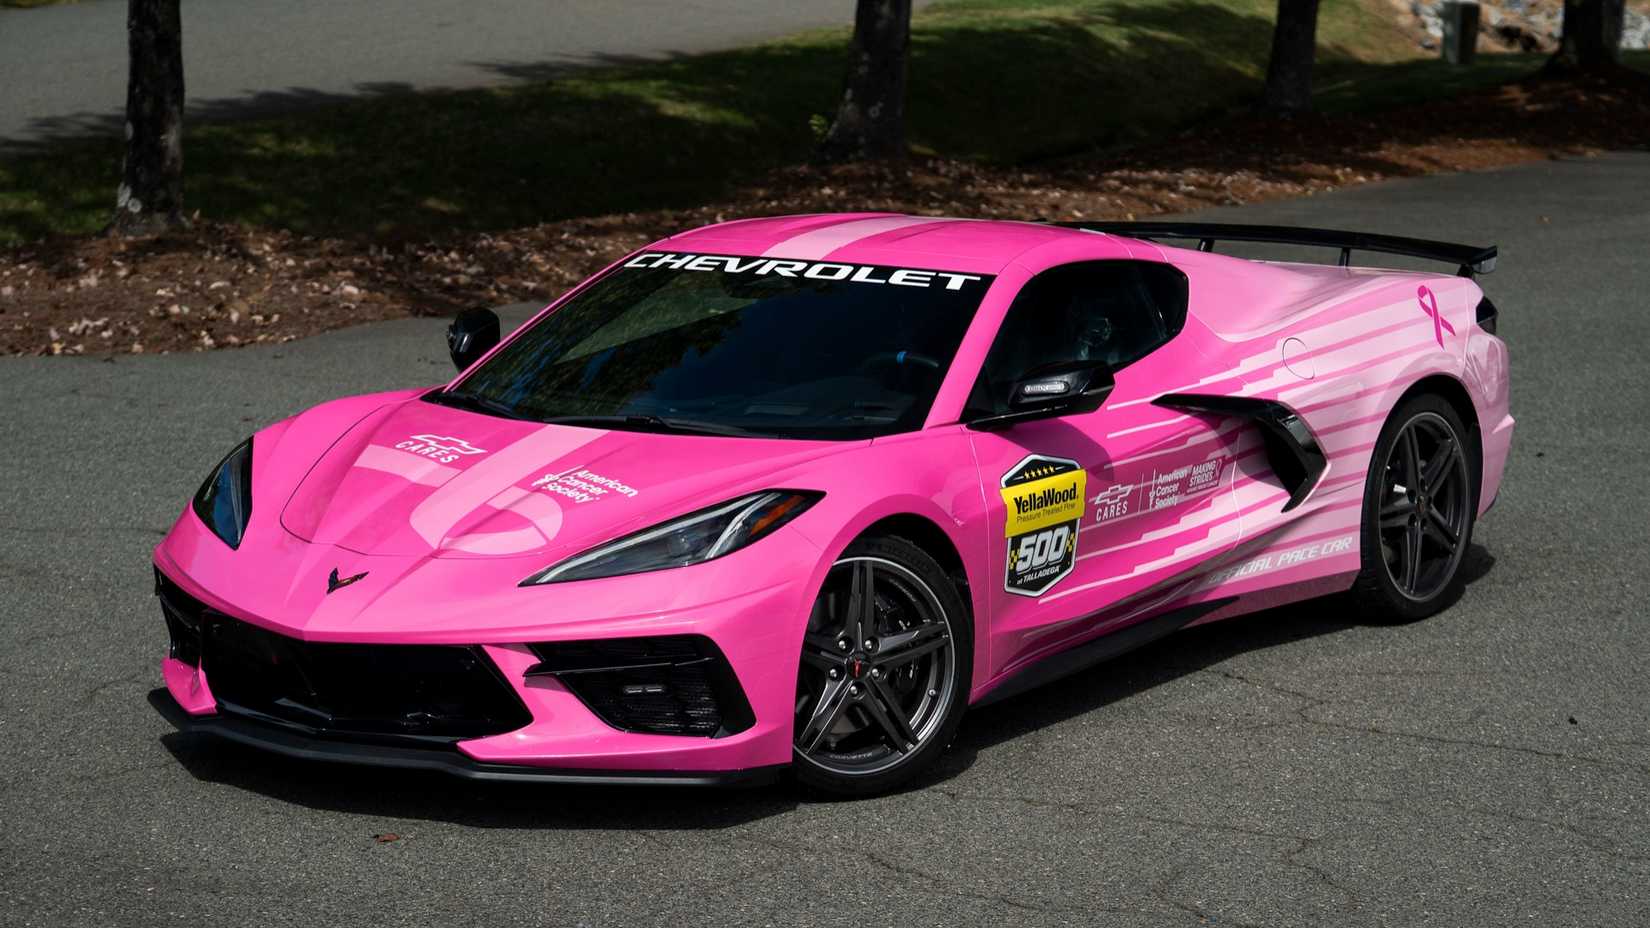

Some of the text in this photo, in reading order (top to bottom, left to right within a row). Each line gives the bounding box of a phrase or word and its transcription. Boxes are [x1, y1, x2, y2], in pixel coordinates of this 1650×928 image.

[623, 253, 981, 291] CHEVROLET
[395, 440, 459, 463] CARES
[557, 476, 608, 495] Cancer
[571, 470, 638, 498] American
[1157, 469, 1188, 485] American
[546, 483, 594, 503] Society
[1013, 482, 1077, 515] YellaWood
[1156, 483, 1179, 497] Cancer
[1016, 502, 1076, 524] Pressure Treated Pine
[1096, 501, 1128, 522] CARES
[1015, 526, 1069, 573] 500
[1276, 545, 1320, 567] PACE
[1320, 537, 1353, 555] CAR
[1023, 565, 1060, 583] TALLADEGA
